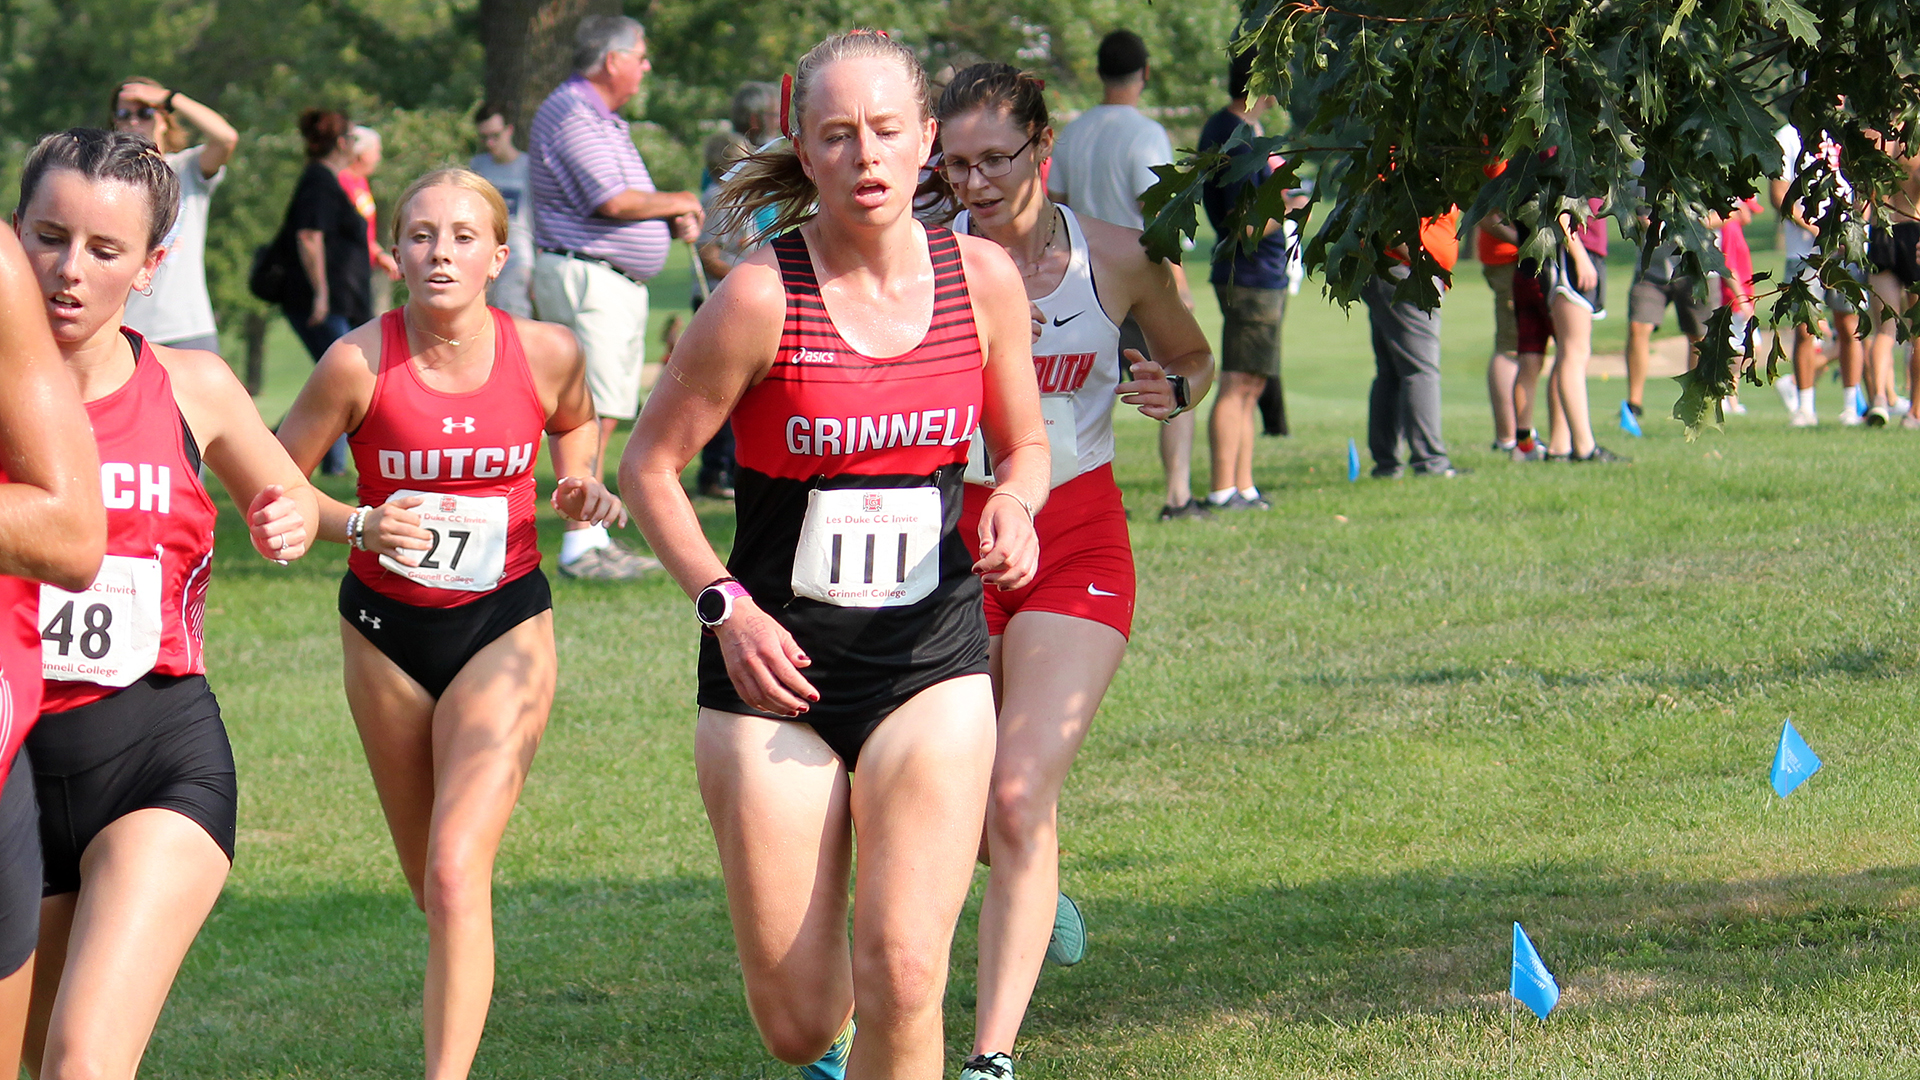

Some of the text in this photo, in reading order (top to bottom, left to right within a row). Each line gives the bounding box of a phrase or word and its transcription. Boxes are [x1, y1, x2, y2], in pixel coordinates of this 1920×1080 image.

[804, 350, 835, 363] asics
[1032, 352, 1098, 394] OUTH
[785, 404, 975, 456] GRINNELL
[378, 442, 534, 480] DUTCH
[424, 512, 447, 522] Duke
[448, 514, 463, 523] CC
[464, 515, 487, 524] Invite
[826, 514, 918, 524] Les Duke CC Invite
[420, 527, 472, 571] 27
[829, 532, 908, 584] 111
[408, 571, 475, 585] Grinnell College
[106, 584, 137, 596] Invite
[827, 589, 906, 599] Grinnell College
[41, 600, 113, 660] 48
[42, 660, 119, 678] innell College
